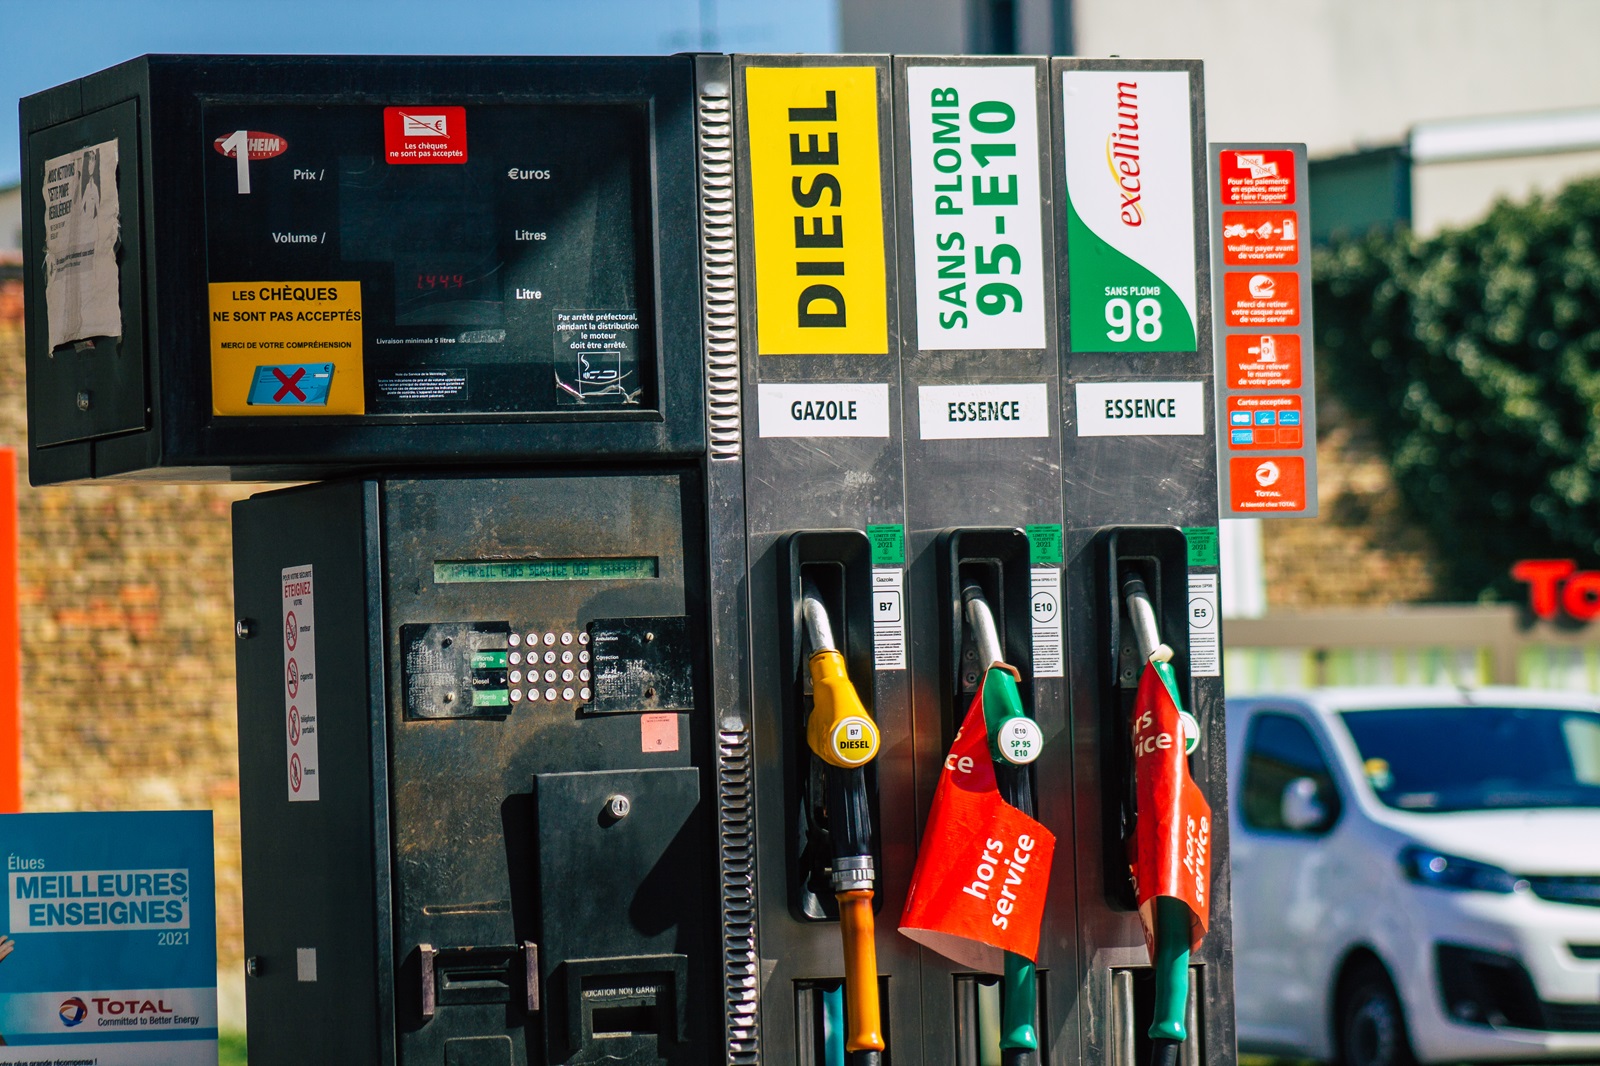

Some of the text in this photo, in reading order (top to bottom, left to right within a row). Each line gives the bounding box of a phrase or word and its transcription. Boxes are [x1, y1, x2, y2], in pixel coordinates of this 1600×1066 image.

[418, 141, 448, 151] chèques
[432, 149, 463, 158] acceptés
[1111, 82, 1142, 227] excellium
[221, 130, 250, 194] 1
[293, 169, 316, 180] Prix
[507, 168, 551, 180] €uros
[1227, 178, 1243, 186] Pour
[1255, 178, 1289, 187] paiements
[1240, 185, 1267, 194] espèces,
[1231, 193, 1287, 202] de faire l'appoint
[788, 90, 847, 329] DIESEL
[931, 86, 968, 330] SANS PLOMB
[968, 100, 1022, 316] 95-E10
[272, 232, 318, 243] Volume
[515, 230, 547, 241] Litres
[232, 285, 338, 302] LES CHÈQUES
[516, 288, 542, 299] Litre
[1104, 286, 1161, 297] SANS PLOMB
[213, 309, 361, 322] NE SONT PAS ACCEPTÉS
[572, 313, 594, 321] arrêté
[596, 313, 638, 322] préfectoral,
[1250, 309, 1273, 317] casque
[1104, 298, 1163, 342] 98
[557, 323, 587, 331] pendant
[597, 322, 640, 330] distribution
[287, 341, 352, 349] COMPRÉHENSION
[587, 341, 602, 349] être
[603, 341, 628, 349] arrêté.
[1238, 363, 1289, 371] Veuillez relever
[1247, 370, 1281, 378] le numéro
[1267, 379, 1291, 387] pompe
[1237, 398, 1292, 407] Cartes acceptées
[790, 400, 858, 422] GAZOLE
[948, 401, 1020, 423] ESSENCE
[1104, 398, 1176, 420] ESSENCE
[877, 541, 893, 549] 2021
[284, 581, 311, 598] ÉTEIGNEZ
[880, 601, 893, 611] B7
[1034, 602, 1052, 612] E10
[1194, 608, 1207, 618] E5
[840, 740, 870, 749] DIESEL
[1010, 740, 1031, 748] SP 95
[1183, 815, 1196, 876] hors
[8, 853, 45, 870] Élues
[1195, 816, 1209, 907] service
[962, 837, 1004, 900] hors
[16, 872, 187, 899] MEILLEURES
[991, 833, 1035, 930] service
[158, 931, 190, 946] 2021
[618, 987, 633, 995] NON
[92, 998, 173, 1015] TOTAL
[97, 1015, 200, 1027] Committed to Better Energy
